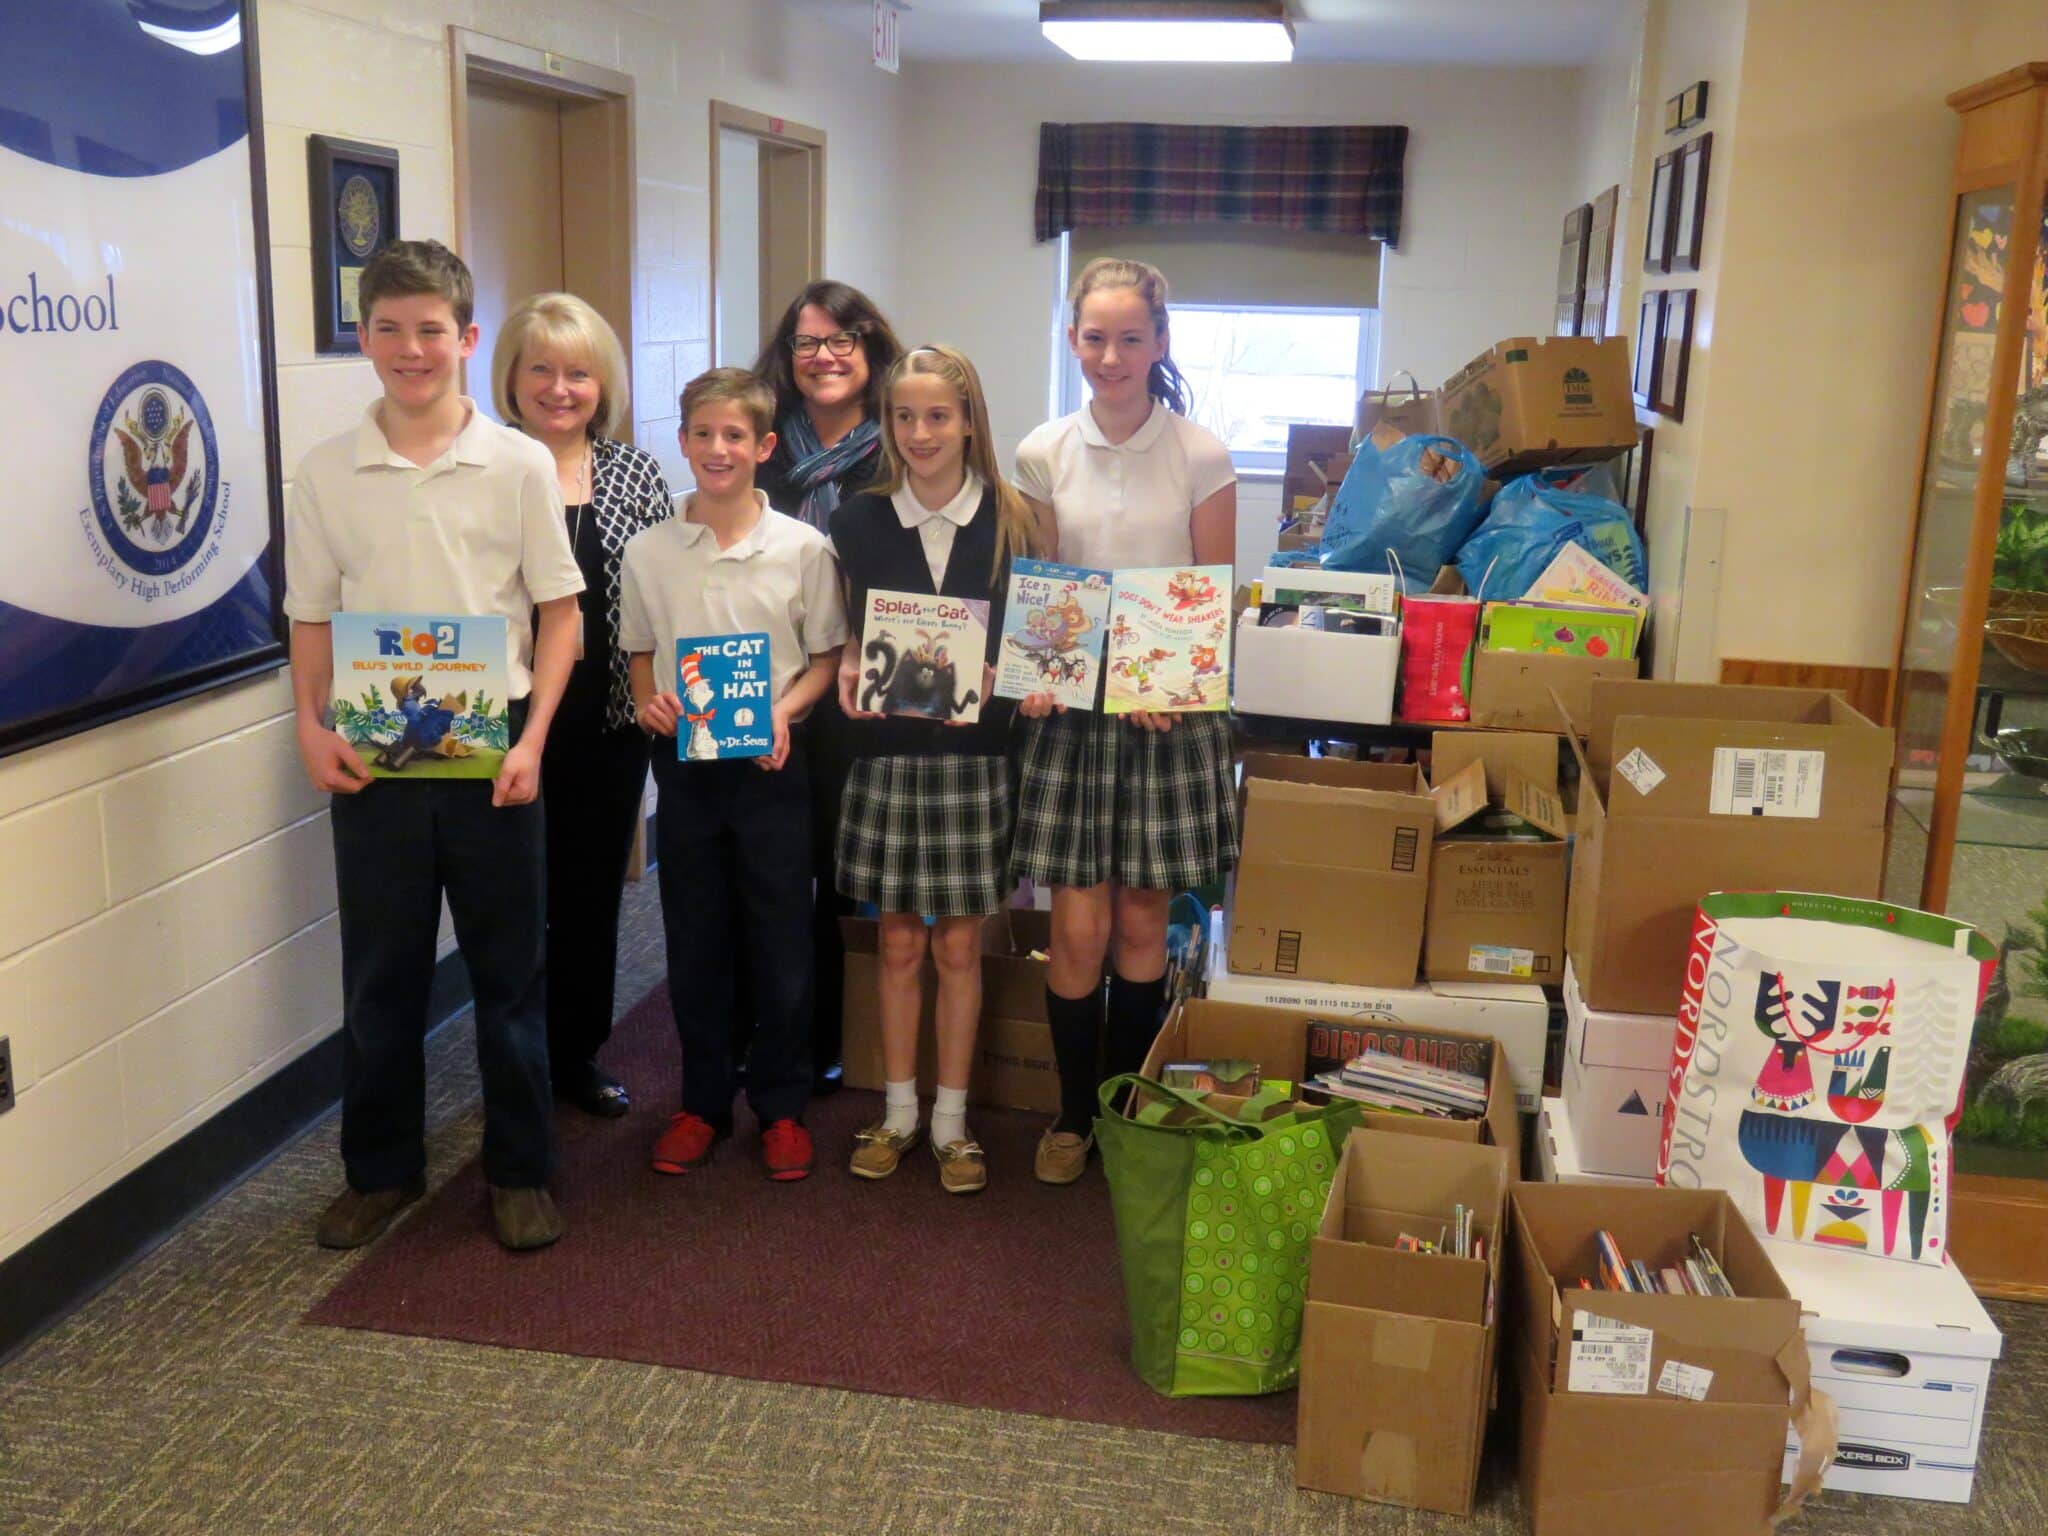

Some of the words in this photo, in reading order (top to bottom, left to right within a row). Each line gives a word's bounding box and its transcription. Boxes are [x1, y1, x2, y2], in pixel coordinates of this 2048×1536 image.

[874, 4, 897, 61] EXIT
[0, 272, 119, 333] chool
[79, 507, 128, 589] Exemplary
[131, 577, 160, 602] High
[164, 542, 219, 596] Performing
[213, 481, 231, 538] School
[1018, 577, 1040, 590] Ice
[1017, 590, 1050, 607] Nice!
[873, 598, 921, 615] Splat
[937, 604, 969, 620] Cat
[1163, 610, 1185, 623] WEAR
[1187, 607, 1225, 624] SNEAKERS
[693, 645, 720, 656] THE
[722, 639, 765, 657] CAT
[352, 660, 387, 671] BLU'S
[391, 662, 424, 671] WILD
[428, 662, 486, 672] JOURNEY
[737, 659, 752, 668] IN
[732, 670, 757, 680] THE
[723, 681, 768, 699] HAT
[1458, 864, 1530, 876] ESSENTIALS
[1311, 1027, 1480, 1074] DINOSAURS
[1667, 931, 1740, 1188] NORDSTRO
[1836, 1451, 1874, 1463] KERS
[1875, 1454, 1904, 1465] BOX
